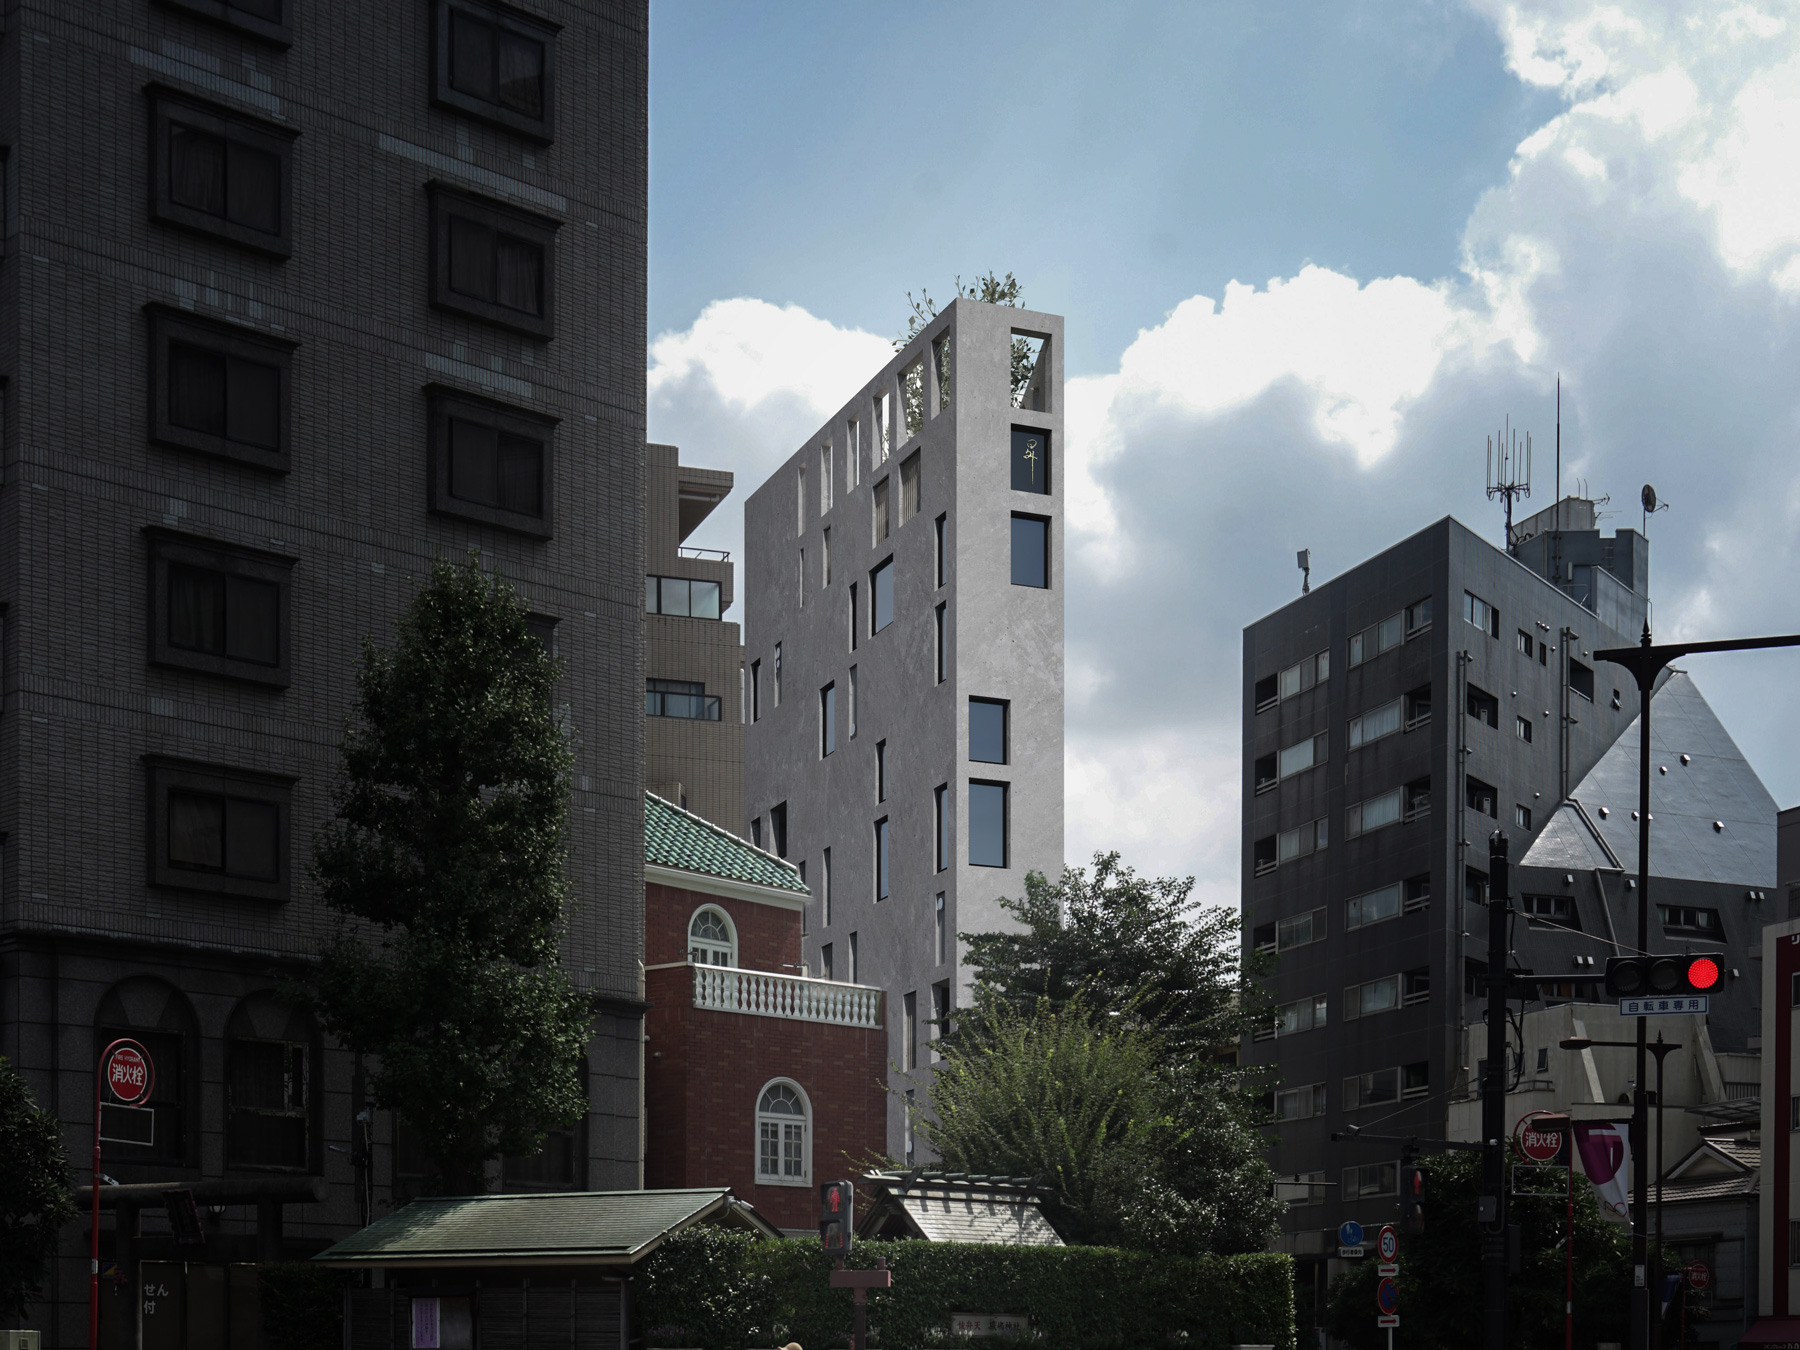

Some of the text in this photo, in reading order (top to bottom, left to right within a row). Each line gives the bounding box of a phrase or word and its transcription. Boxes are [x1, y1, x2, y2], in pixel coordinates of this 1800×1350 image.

[1628, 999, 1700, 1012] 自転車専用
[112, 1063, 144, 1086] 消火栓
[1525, 1131, 1558, 1148] 消火栓
[1383, 1237, 1395, 1253] 50
